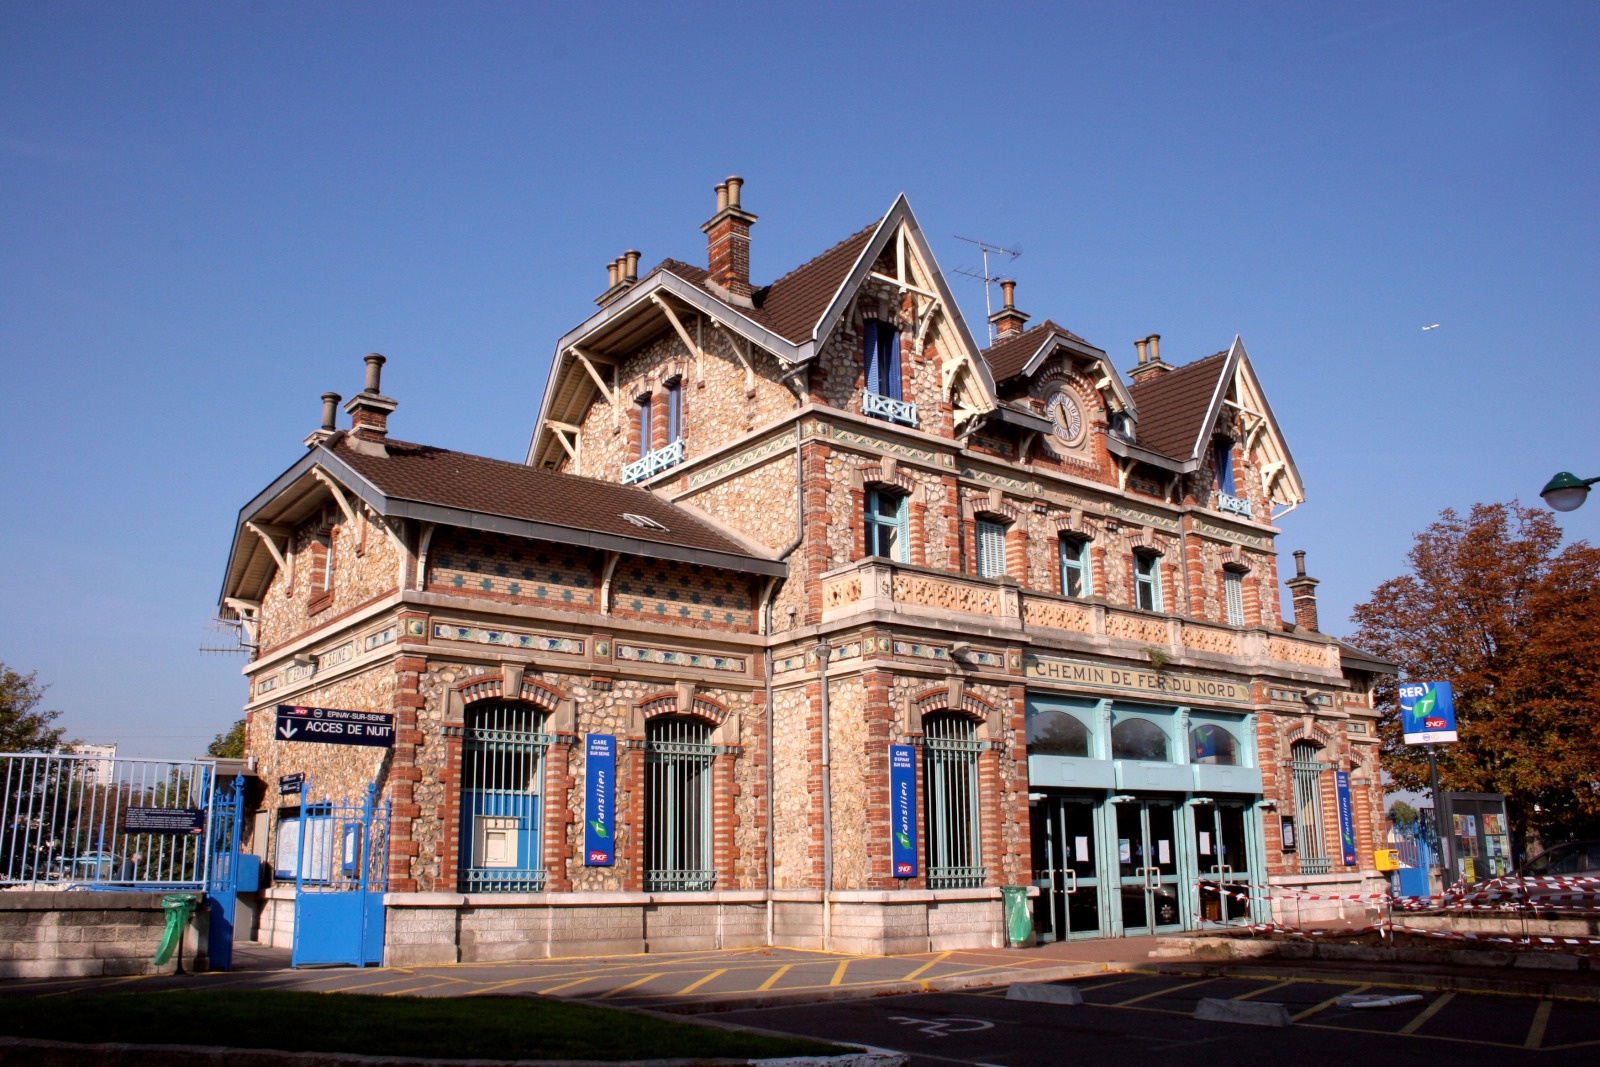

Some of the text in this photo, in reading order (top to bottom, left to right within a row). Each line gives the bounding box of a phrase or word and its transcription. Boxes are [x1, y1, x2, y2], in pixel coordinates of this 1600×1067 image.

[1035, 662, 1235, 697] CHEMIN DE FER DU NORD
[1399, 686, 1424, 698] RER
[1421, 700, 1434, 713] T
[327, 710, 386, 722] EPINAY-SUR-SEINE
[305, 721, 391, 737] ACCES DE NUIT
[1425, 720, 1444, 728] SNCF
[596, 770, 605, 832] Transilien
[900, 782, 909, 843] Transilien
[897, 865, 912, 873] SNCF
